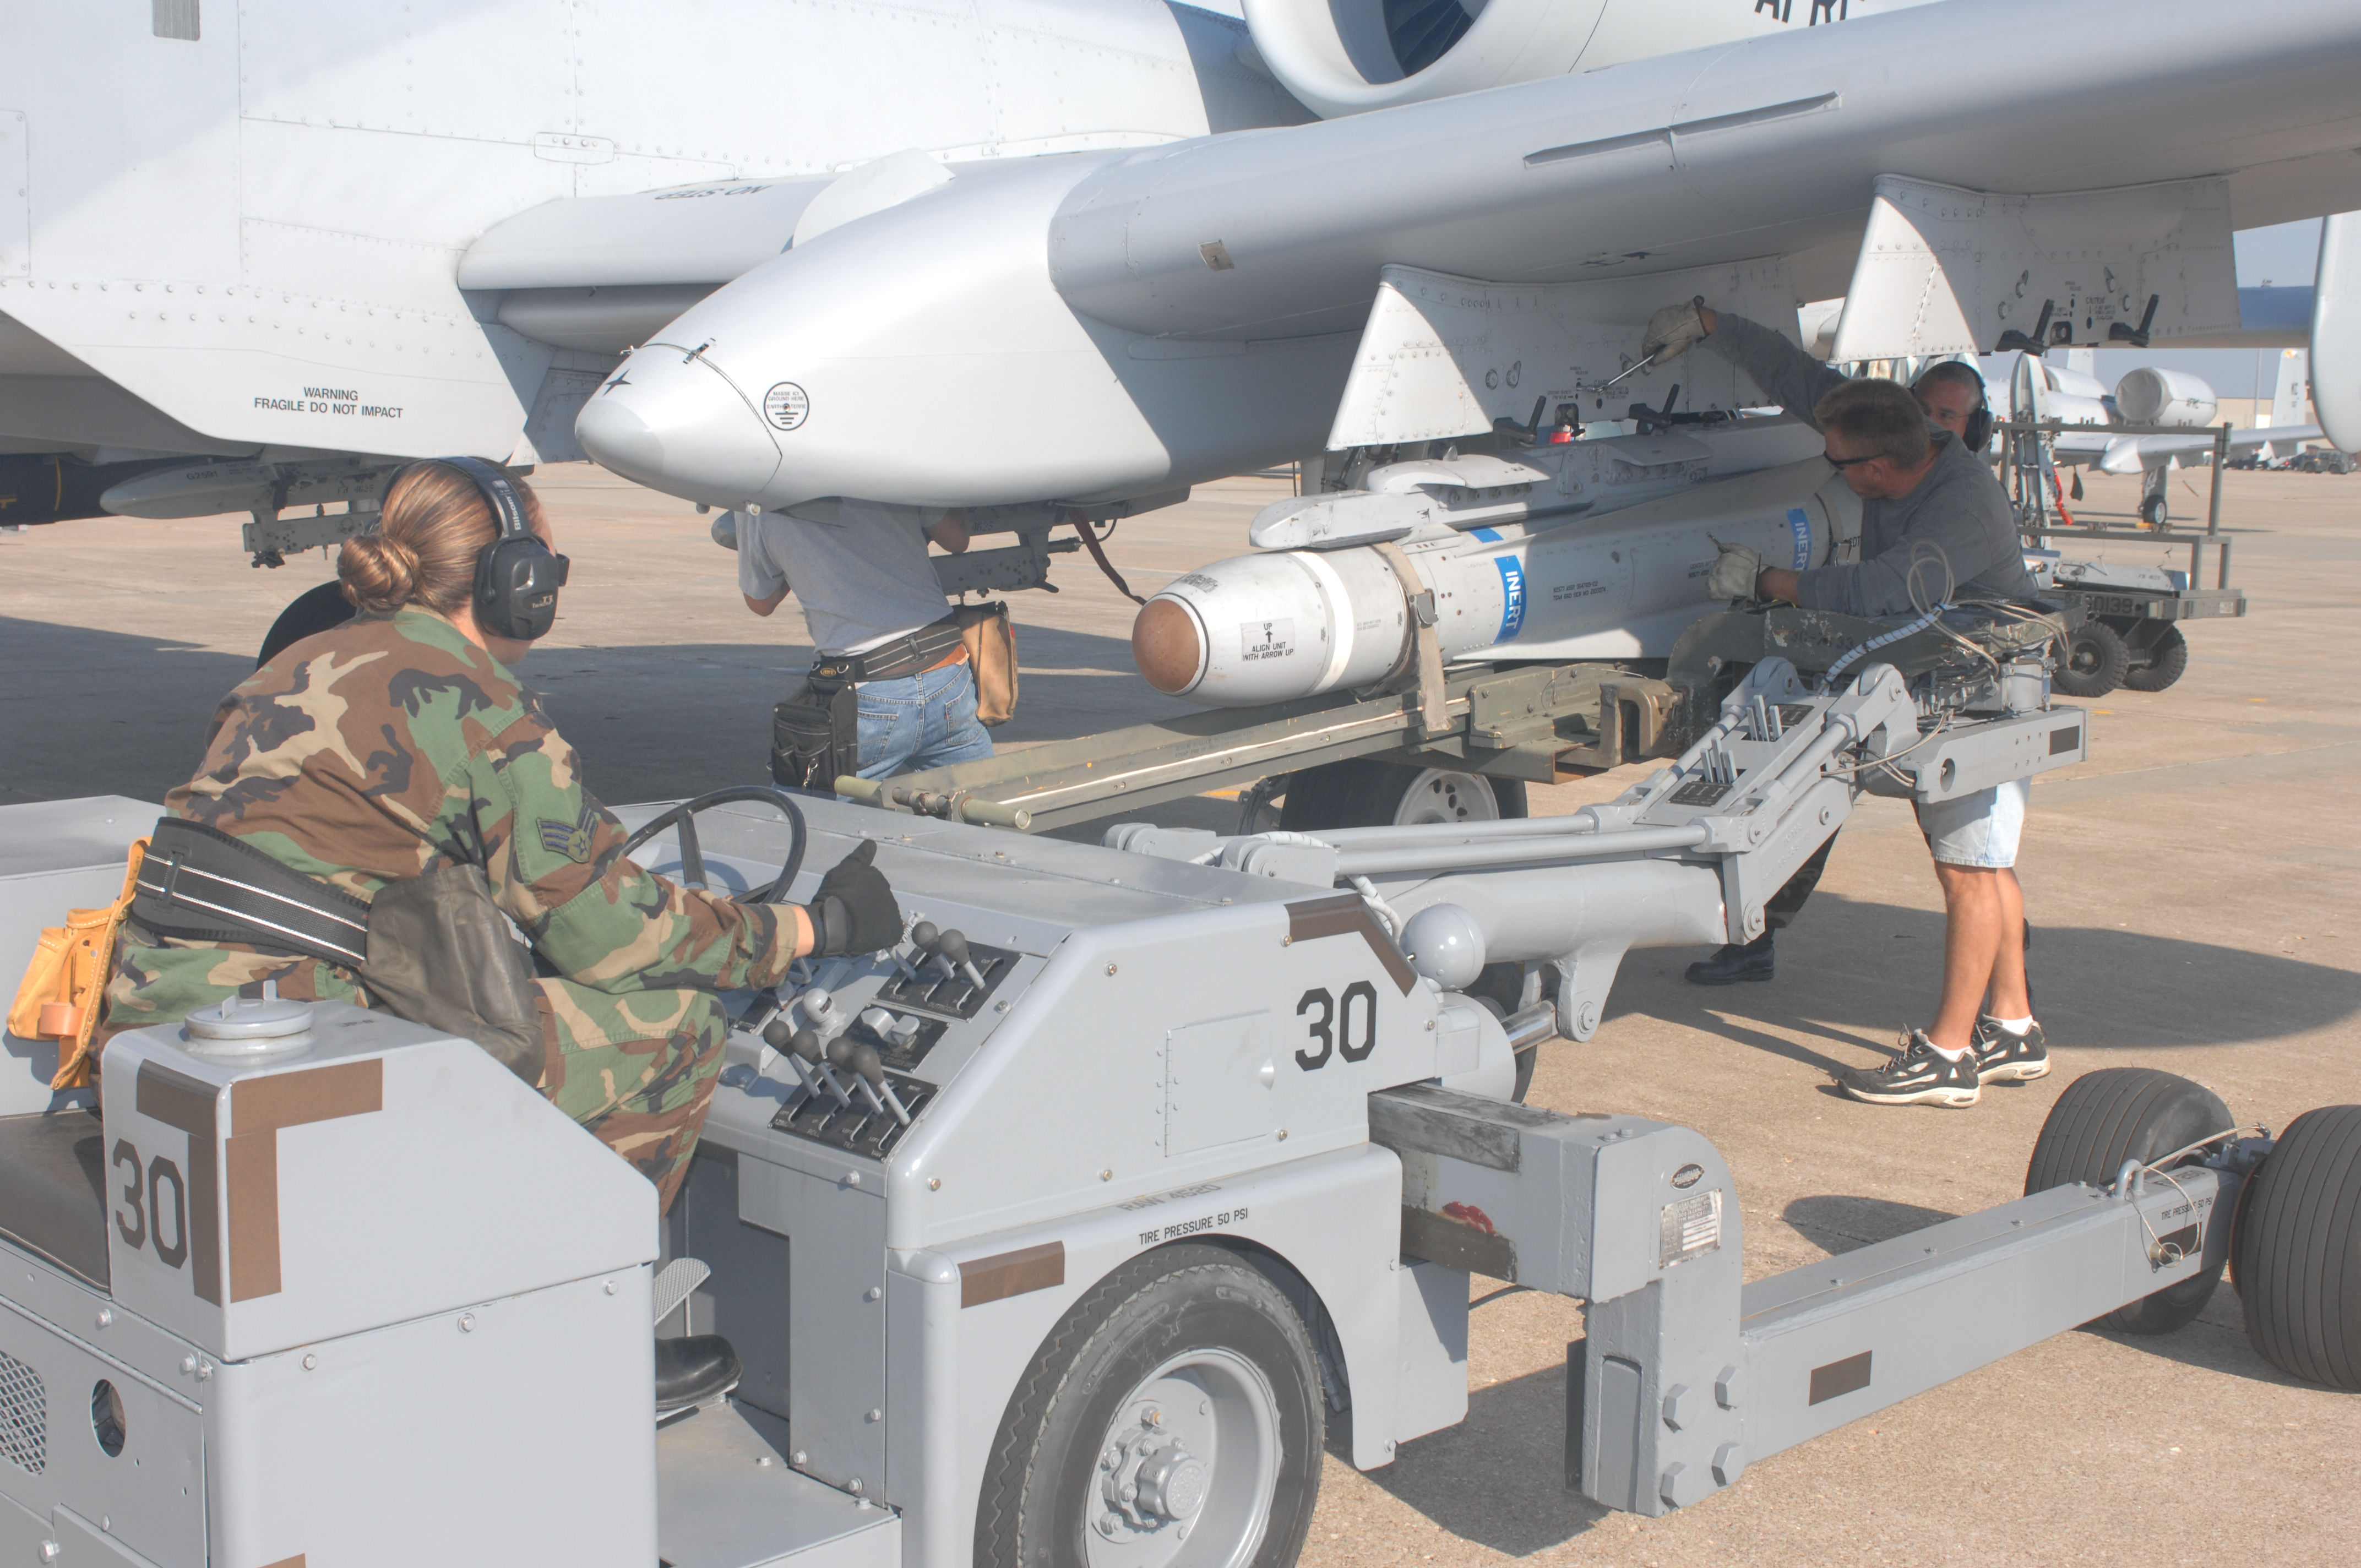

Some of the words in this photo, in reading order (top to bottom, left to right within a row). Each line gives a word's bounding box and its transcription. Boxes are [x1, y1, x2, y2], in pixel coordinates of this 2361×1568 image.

[303, 386, 358, 401] WARNING
[254, 398, 304, 411] FRAGILE
[310, 401, 328, 413] DO
[333, 403, 357, 415] NOT
[362, 405, 403, 418] IMPACT
[1505, 570, 1521, 629] INERT
[1243, 653, 1259, 662] WITH
[1261, 650, 1283, 660] ARROW
[1252, 644, 1270, 652] ALIGN
[1272, 641, 1286, 650] UNIT
[1295, 980, 1377, 1072] 30
[113, 1137, 188, 1270] 30
[1117, 1197, 1166, 1211] RAW
[1168, 1184, 1222, 1199] 4520
[1139, 1229, 1160, 1245] TIRE
[1164, 1216, 1214, 1239] PRESSURE
[1217, 1212, 1230, 1226] 50
[1234, 1207, 1248, 1222] PSI
[2162, 1210, 2171, 1221] TIRE
